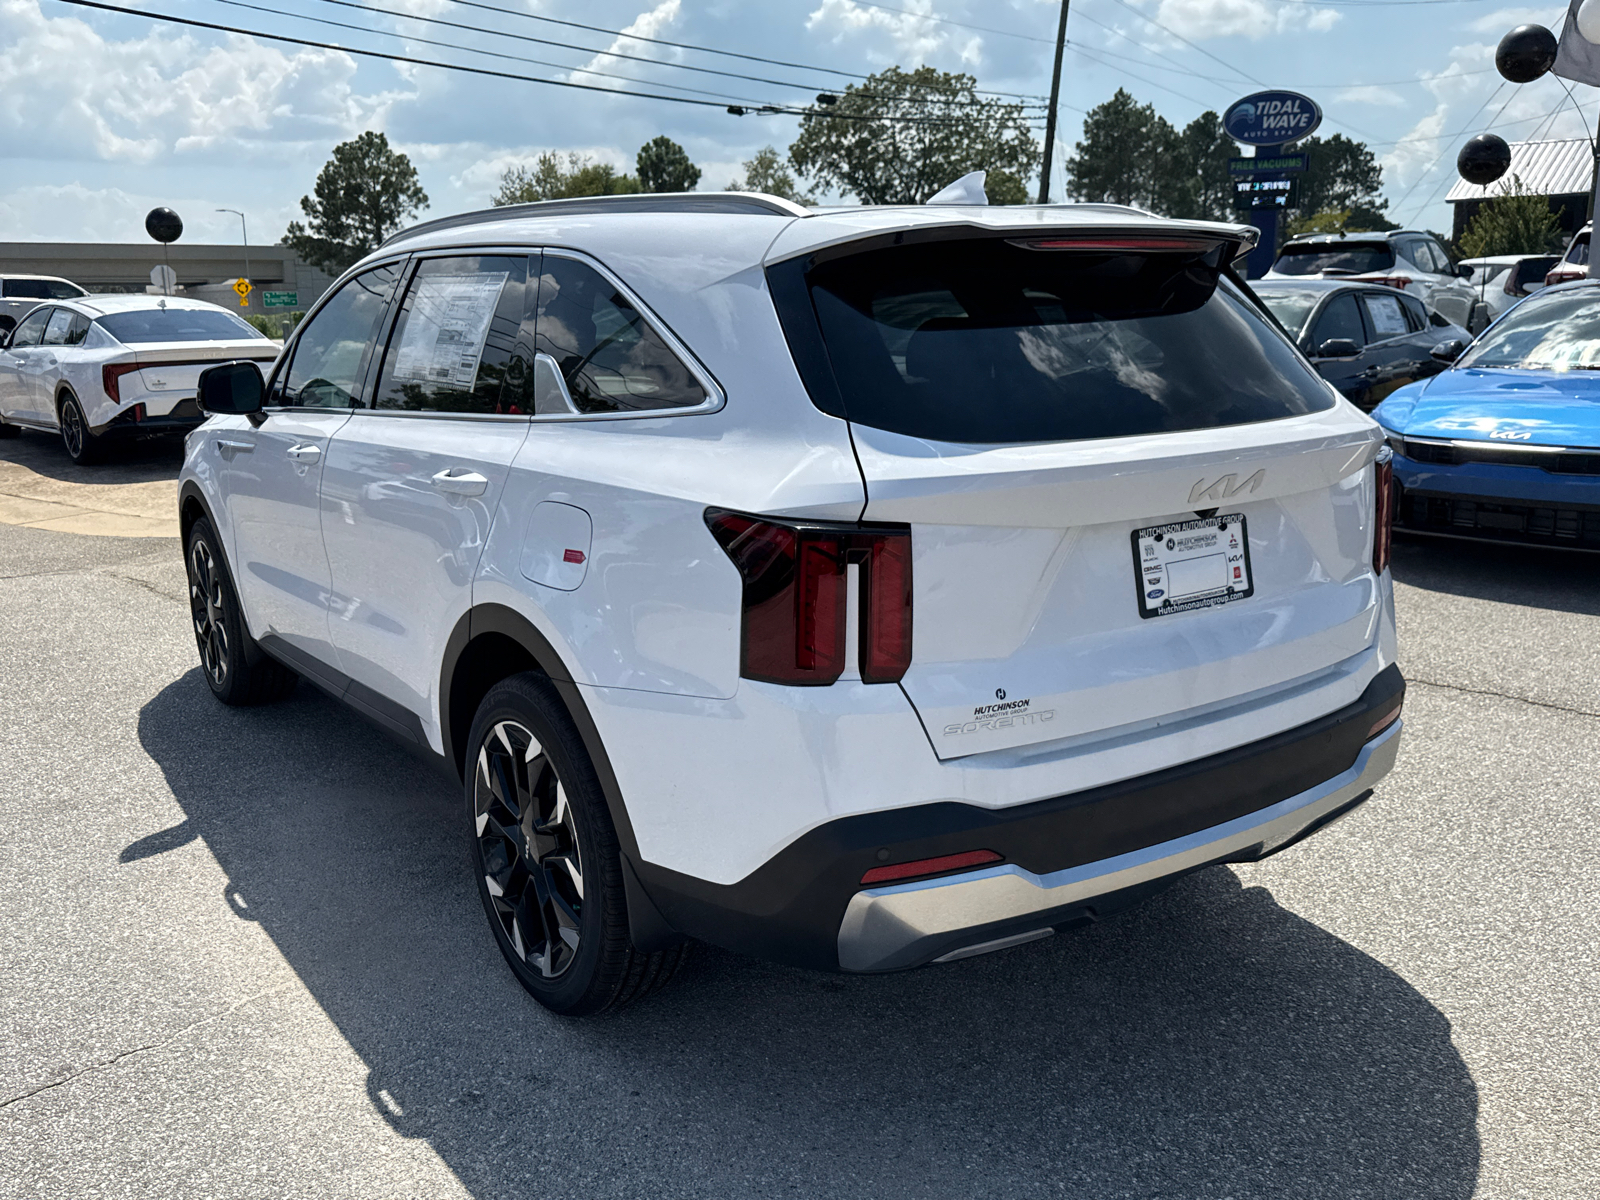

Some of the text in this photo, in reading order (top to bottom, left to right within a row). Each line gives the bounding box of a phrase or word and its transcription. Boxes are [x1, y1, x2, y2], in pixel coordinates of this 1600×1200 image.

[1256, 100, 1301, 115] TIDAL
[1262, 113, 1310, 129] WAVE
[1230, 158, 1302, 170] FREE VACUUMS
[1489, 430, 1532, 440] KIA
[1187, 468, 1266, 504] KIA
[1139, 514, 1244, 539] HUTCHINSON AUTOMOTIVE GROUP
[1176, 533, 1217, 547] HUTCHINSON
[1143, 564, 1162, 573] GMC
[1158, 592, 1244, 615] Hutchinsonautogroup.com
[974, 699, 1030, 715] HUTCHINSON
[975, 707, 1028, 720] AUTOMOTIVE GROUP
[943, 709, 1056, 736] SORENTO
